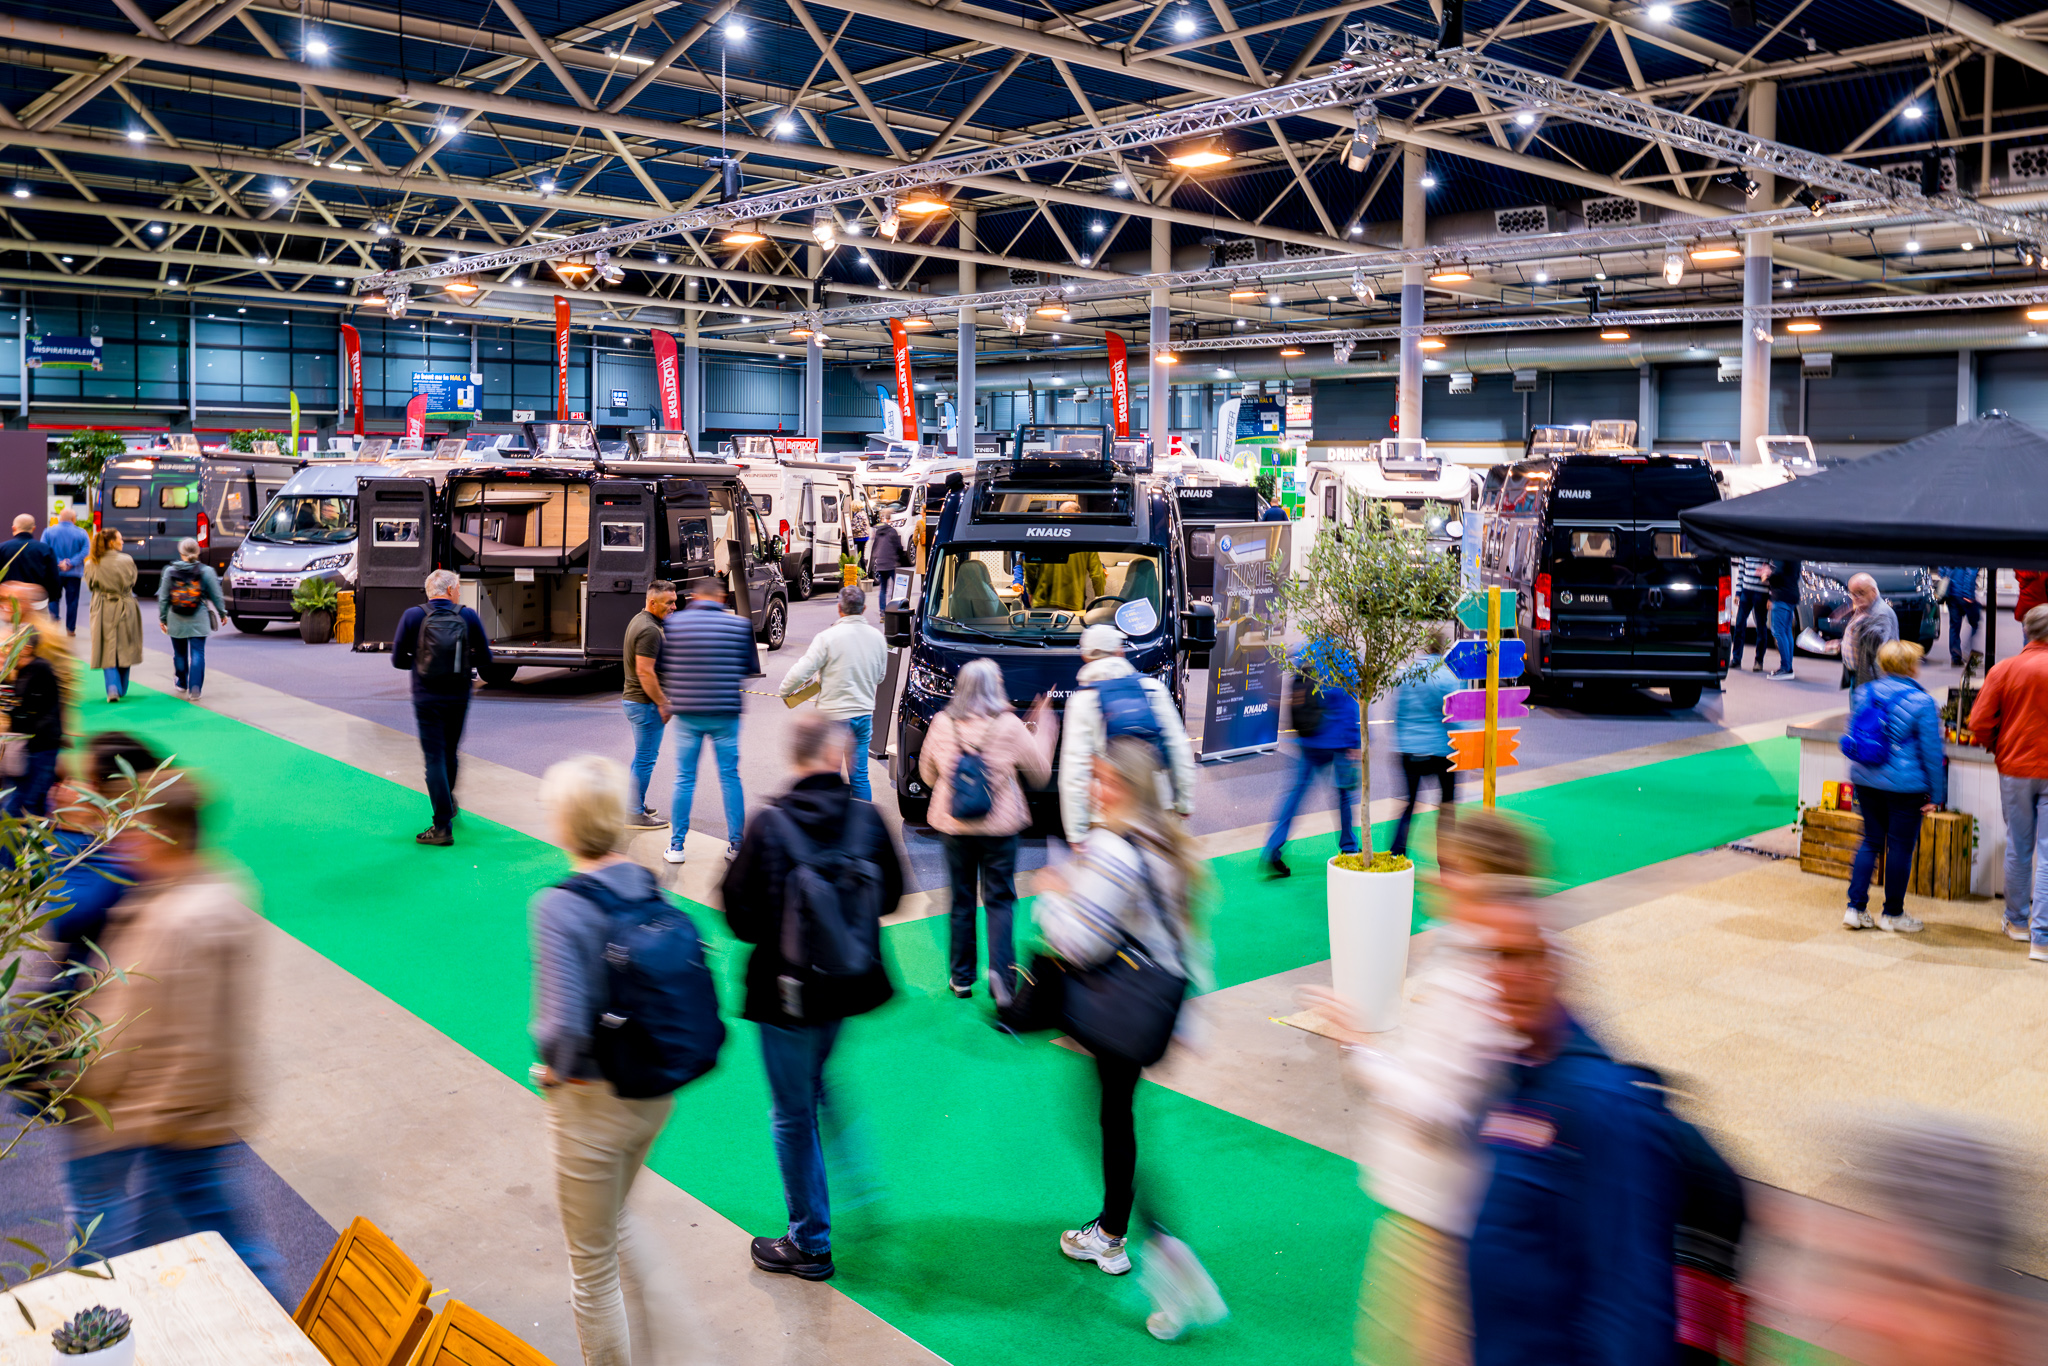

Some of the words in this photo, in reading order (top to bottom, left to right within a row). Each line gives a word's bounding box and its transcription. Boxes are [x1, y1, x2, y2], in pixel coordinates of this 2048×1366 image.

[32, 346, 95, 356] INSPIRATIEPLEIN
[1224, 411, 1236, 461] DREAMER
[1180, 489, 1213, 498] KNAUS
[1558, 489, 1592, 500] KNAUS
[1025, 527, 1072, 538] KNAUS
[1224, 561, 1274, 588] TIME
[1227, 589, 1239, 597] voor
[1252, 586, 1274, 594] innovatie
[1580, 595, 1594, 603] BOX
[1595, 595, 1609, 603] LIFE
[1046, 690, 1064, 698] BOX
[1243, 703, 1268, 715] KNAUS
